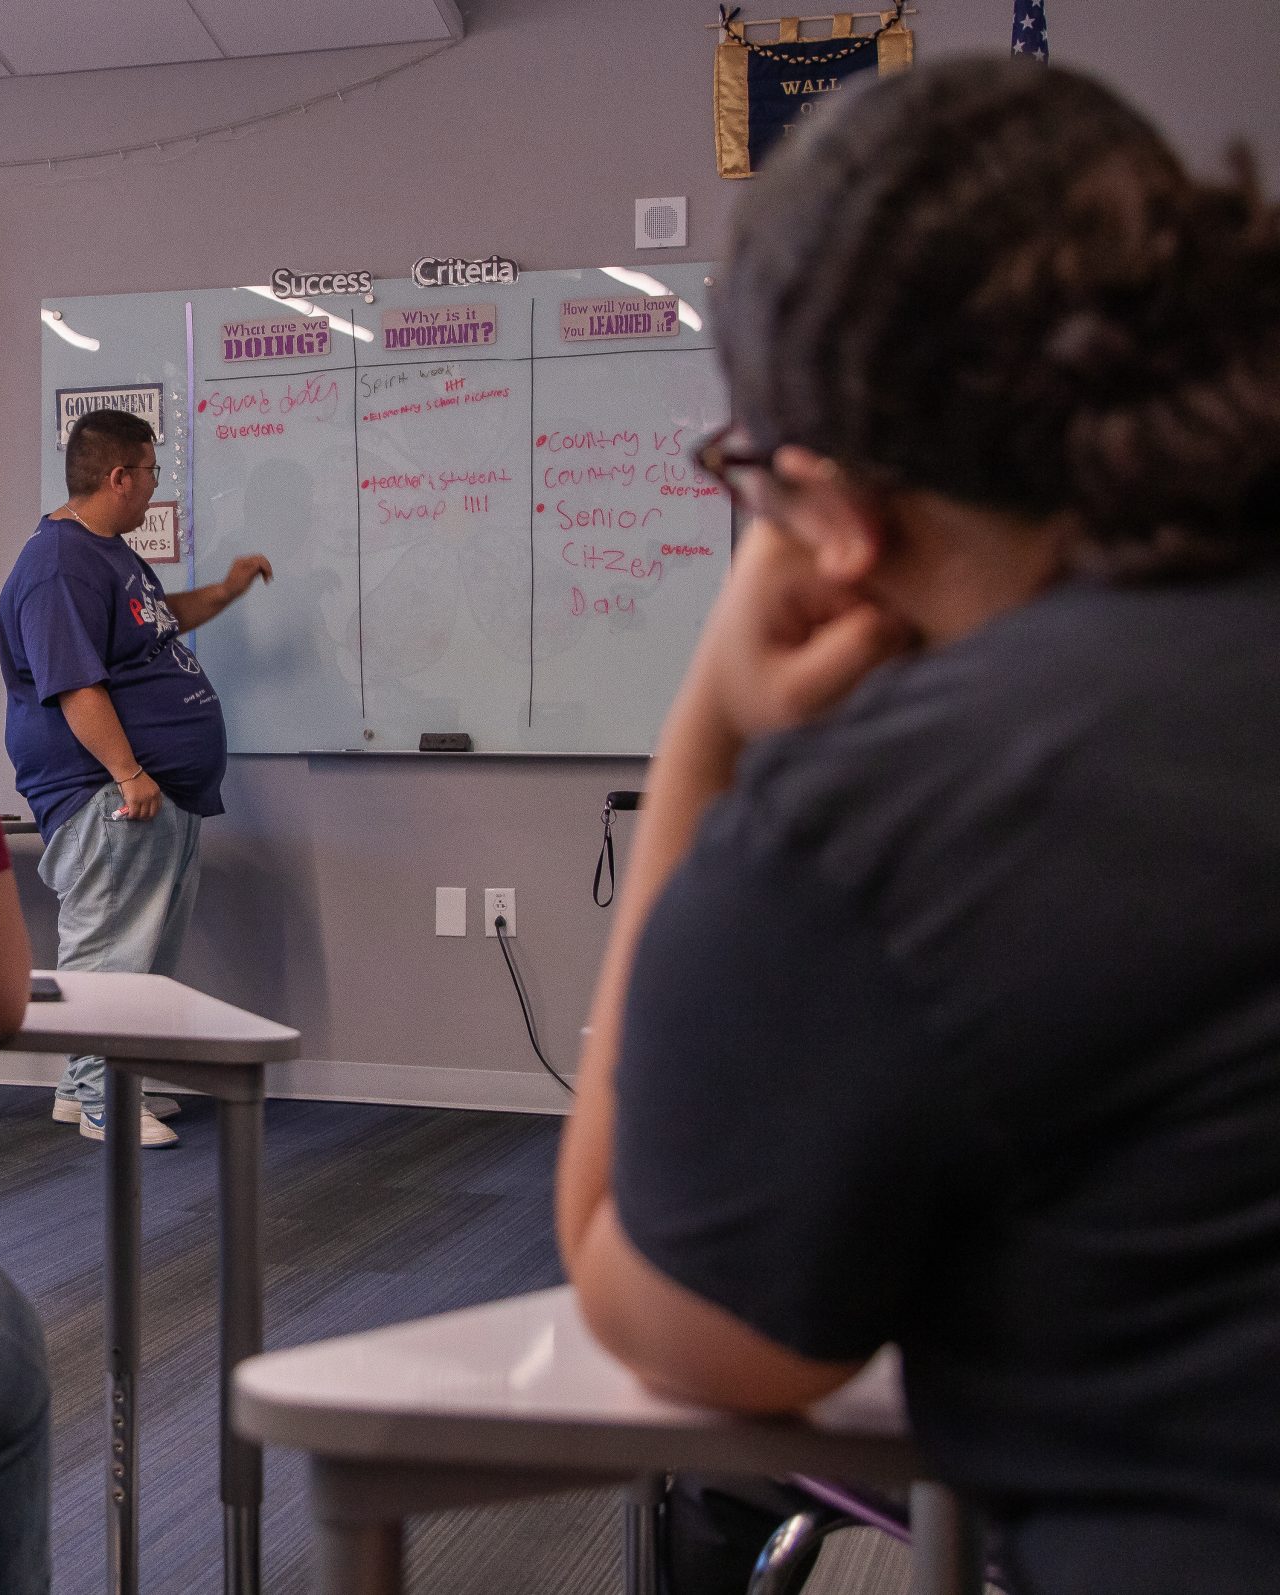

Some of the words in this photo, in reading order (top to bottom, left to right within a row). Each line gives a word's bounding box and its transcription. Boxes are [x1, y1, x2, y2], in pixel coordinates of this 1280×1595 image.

[780, 78, 843, 94] WALL
[274, 269, 371, 297] Success
[415, 255, 514, 286] Criteria
[402, 310, 440, 325] Why
[446, 309, 460, 321] is
[466, 308, 477, 320] it
[563, 302, 589, 315] How
[592, 301, 615, 313] will
[618, 301, 640, 314] you
[643, 299, 677, 311] know
[224, 325, 266, 337] What
[271, 324, 297, 333] are
[303, 321, 328, 331] we
[385, 321, 494, 348] IMPORTANT?
[563, 327, 585, 339] you
[589, 313, 652, 336] LEARNED
[224, 332, 328, 360] DOING?
[65, 393, 155, 417] GOVERNMENT
[548, 430, 640, 456] Country
[556, 500, 662, 530] Senior
